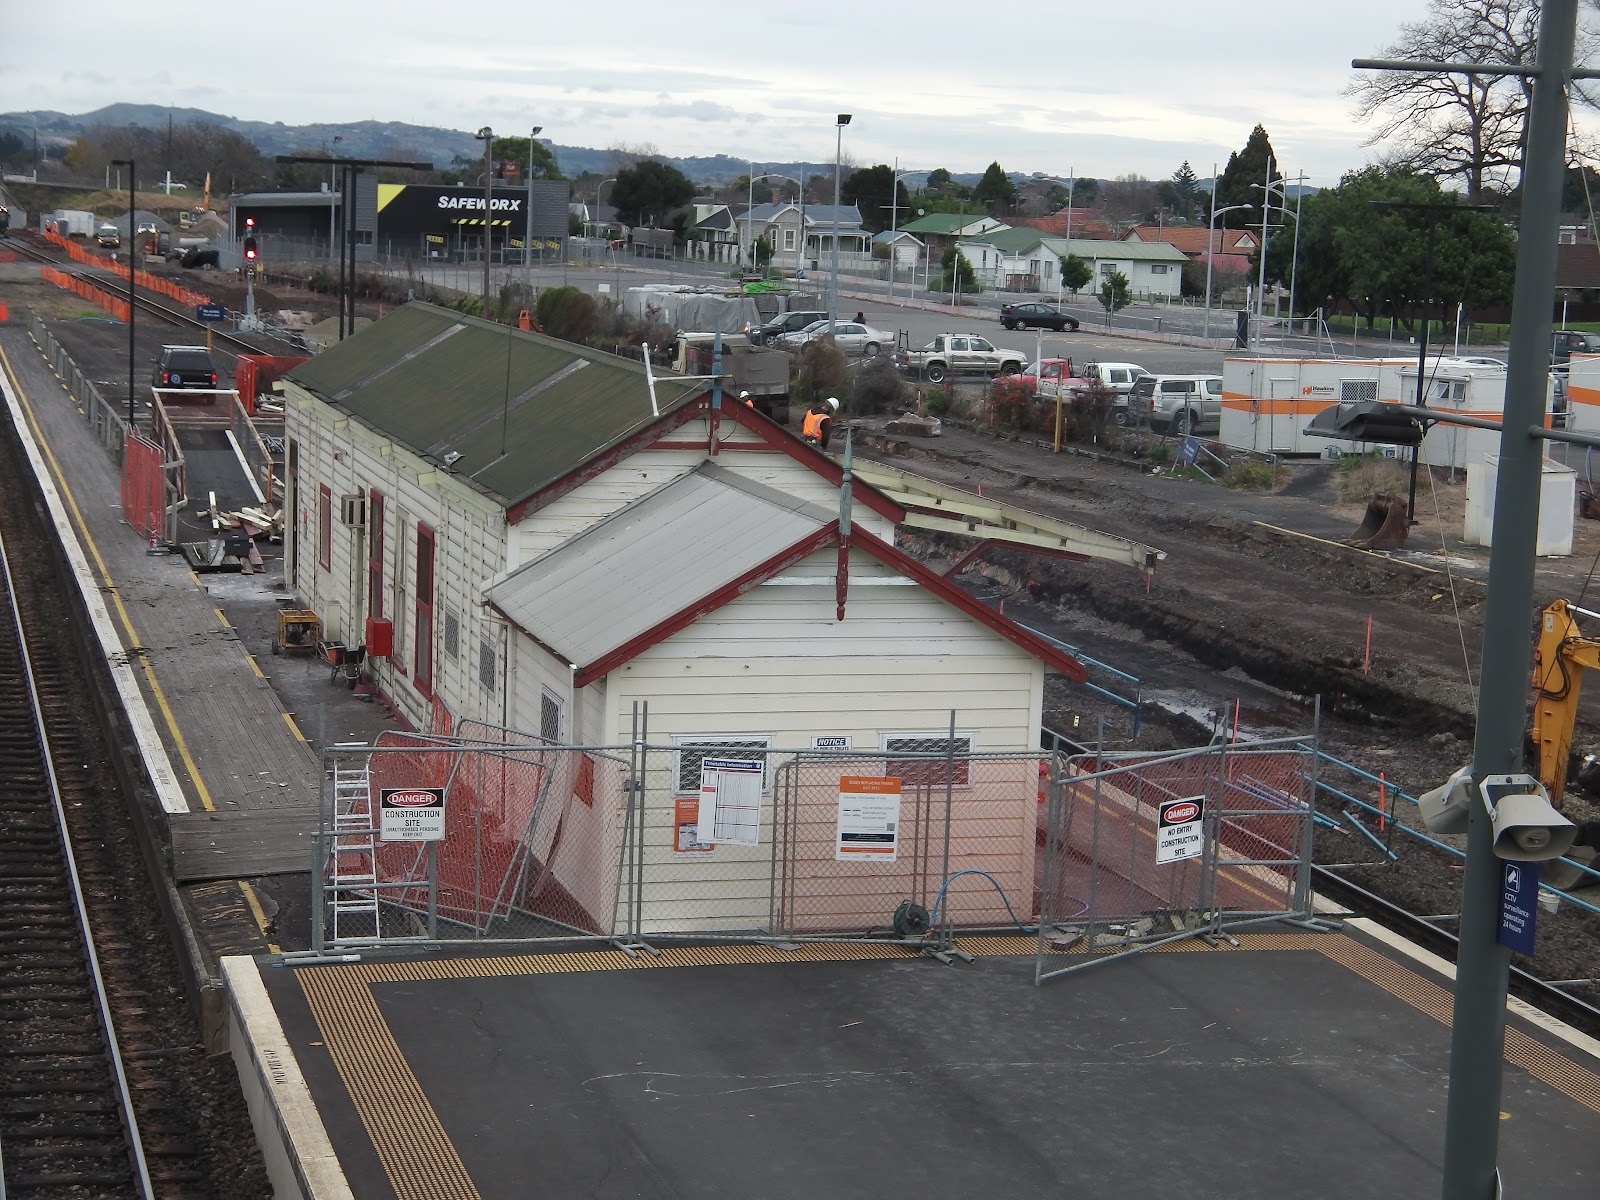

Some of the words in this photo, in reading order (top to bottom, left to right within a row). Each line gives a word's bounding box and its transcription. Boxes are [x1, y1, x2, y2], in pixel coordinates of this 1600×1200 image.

[437, 195, 521, 211] SAFEWORX
[818, 738, 845, 746] NOTICE
[1168, 807, 1194, 819] DANGER
[1167, 828, 1176, 836] NO
[1176, 825, 1193, 834] ENTRY
[1161, 834, 1199, 848] CONSTRUCTION
[1174, 848, 1186, 856] SITE
[1505, 893, 1516, 902] CCTV
[1504, 903, 1529, 917] surveillance
[1504, 912, 1525, 927] operating
[1503, 920, 1508, 928] 24
[1509, 923, 1521, 933] hours
